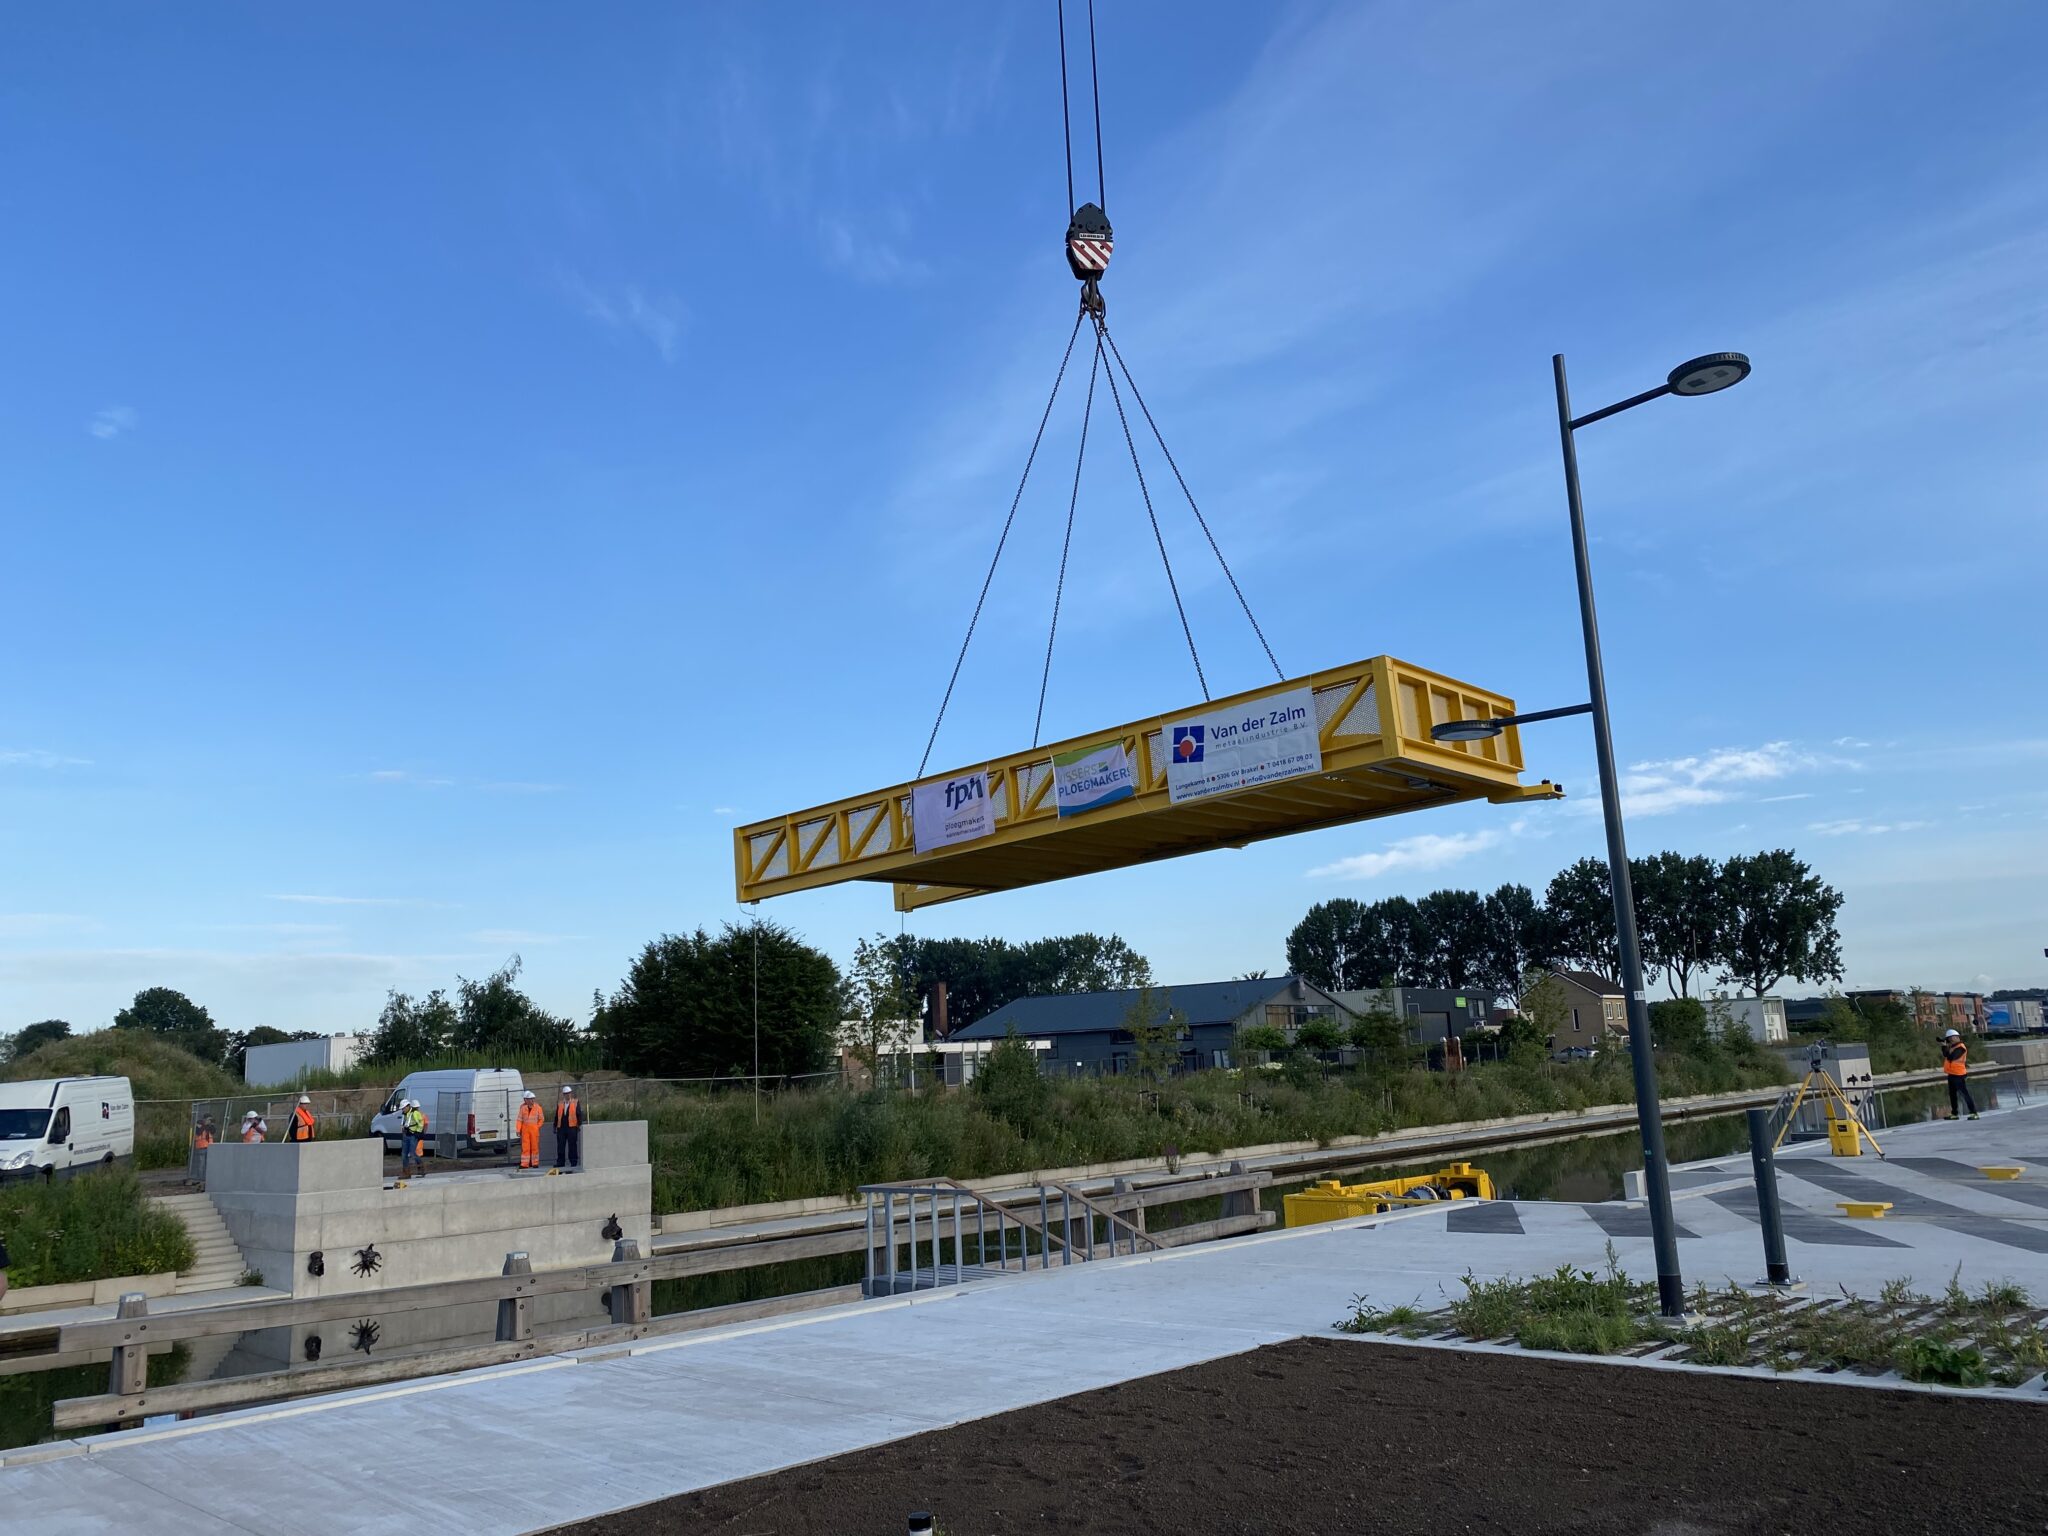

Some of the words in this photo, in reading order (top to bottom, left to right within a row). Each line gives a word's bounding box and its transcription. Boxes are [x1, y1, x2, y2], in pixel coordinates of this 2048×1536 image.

[1211, 725, 1238, 740] Van
[1242, 717, 1266, 732] der
[1269, 706, 1306, 726] Zalm
[1215, 727, 1289, 750] metaalindustrie
[1057, 763, 1097, 784] VISSERS
[1231, 769, 1240, 777] GV
[1246, 763, 1315, 784] info@vanderzalmbv.nl
[945, 775, 984, 811] fph
